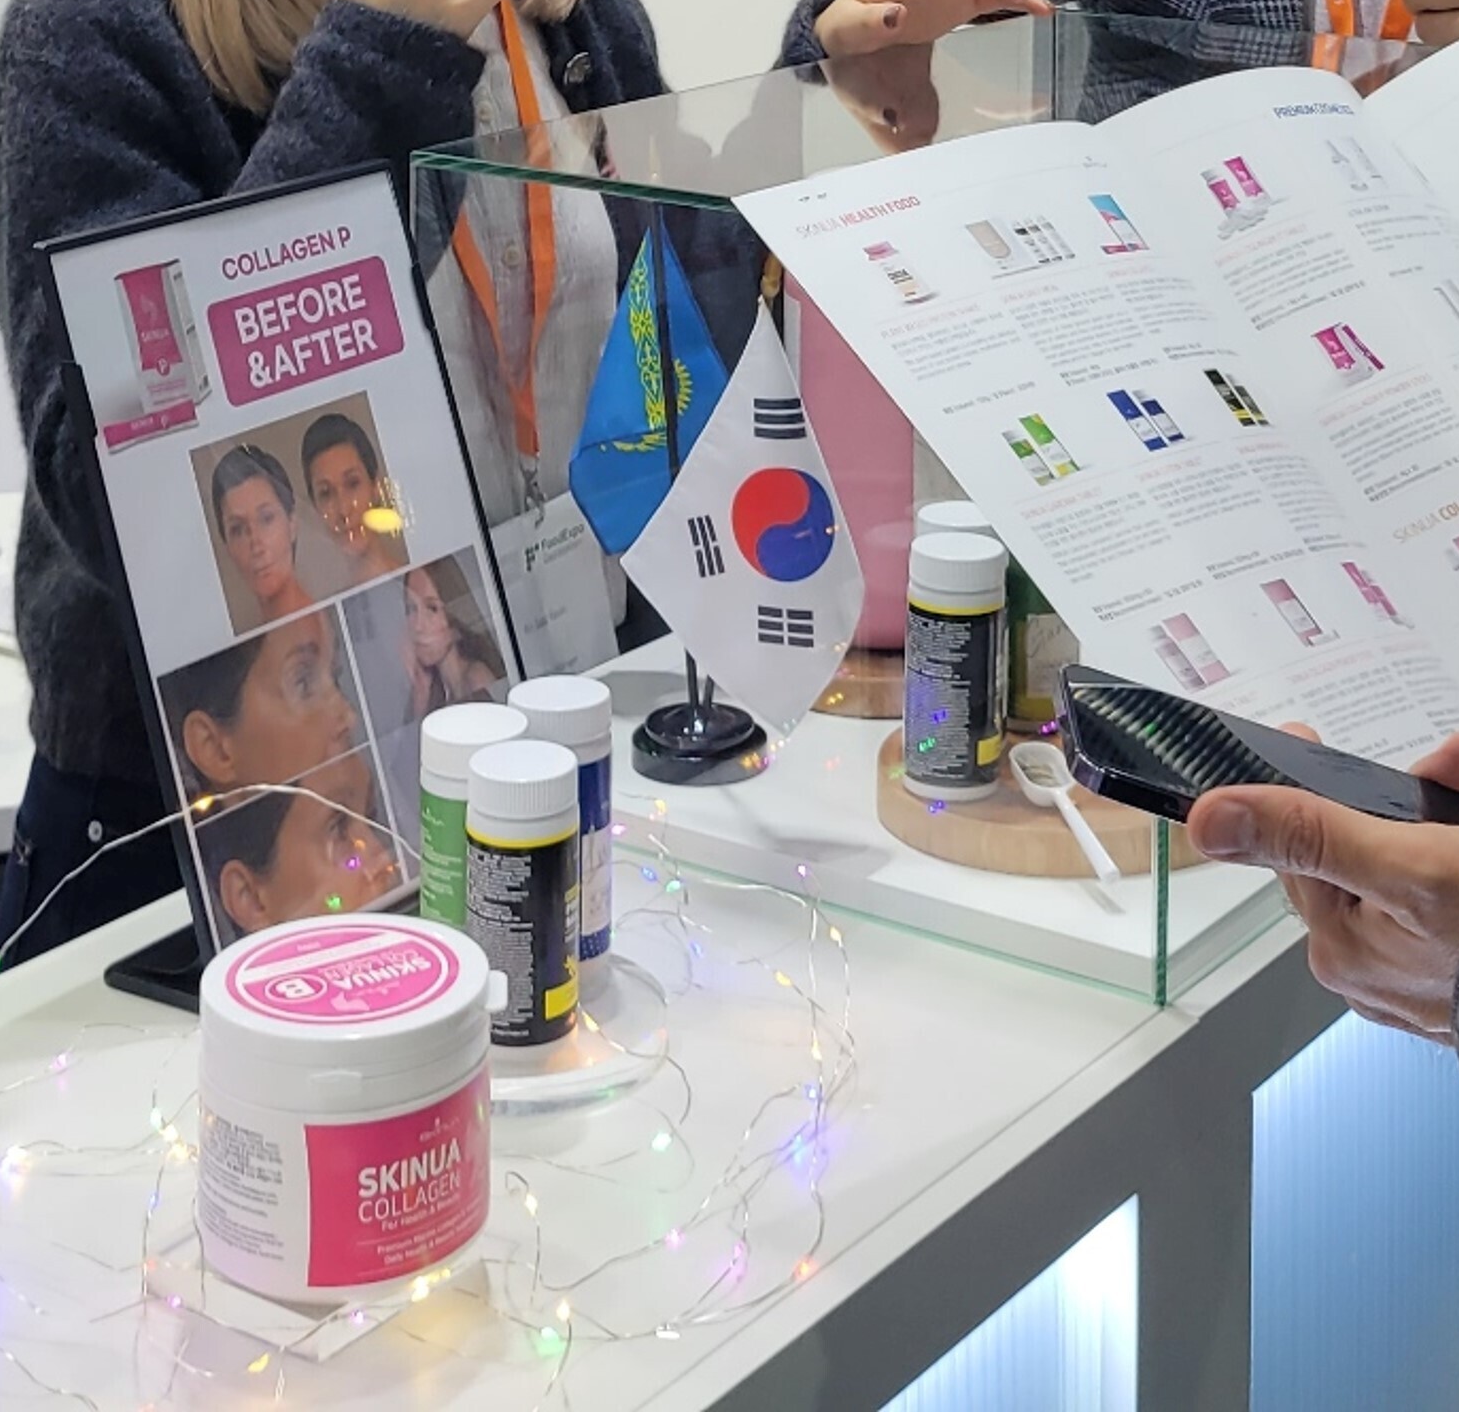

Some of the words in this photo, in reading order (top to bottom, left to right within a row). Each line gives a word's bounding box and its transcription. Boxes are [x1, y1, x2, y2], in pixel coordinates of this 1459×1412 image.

[222, 230, 335, 280] COLLAGEN
[338, 226, 352, 249] P
[234, 273, 368, 344] BEFORE
[247, 317, 378, 389] &AFTER
[276, 975, 316, 999] B
[332, 955, 432, 993] SKINUA
[358, 1138, 461, 1199] SKINUA
[359, 1172, 461, 1223] COLLAGEN
